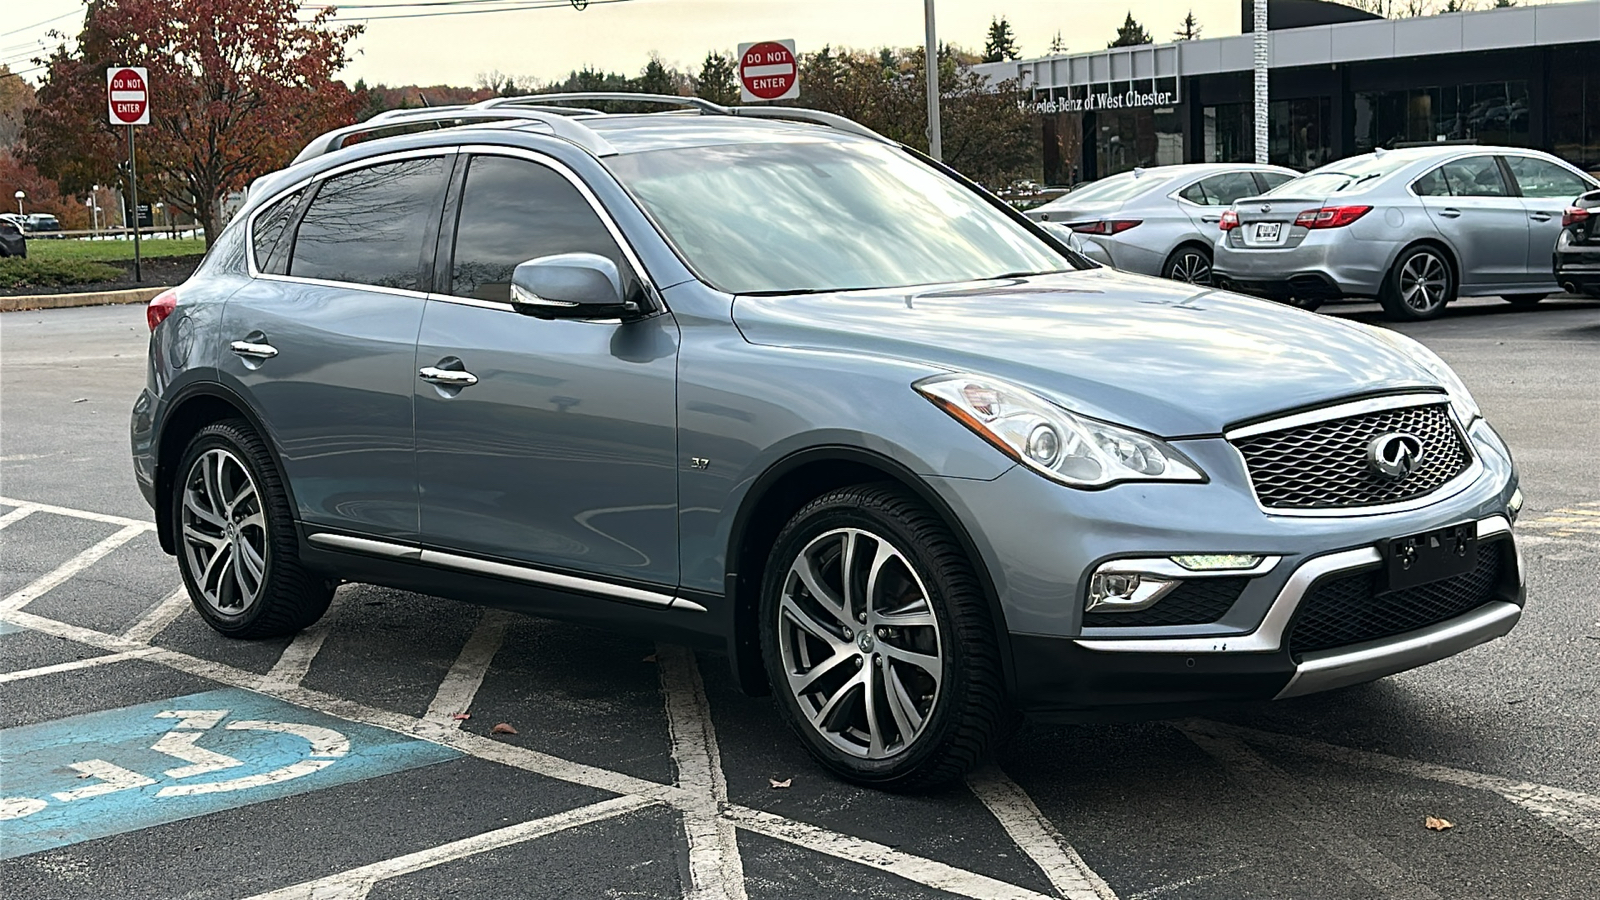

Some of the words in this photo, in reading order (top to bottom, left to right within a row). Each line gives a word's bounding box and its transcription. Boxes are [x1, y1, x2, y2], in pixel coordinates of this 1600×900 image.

[747, 53, 761, 64] DO
[767, 51, 787, 62] NOT
[113, 79, 124, 89] DO
[127, 79, 141, 89] NOT
[753, 77, 786, 89] ENTER
[1084, 94, 1096, 110] of
[1096, 93, 1123, 109] West
[1125, 90, 1172, 107] Chester
[117, 103, 140, 113] ENTER
